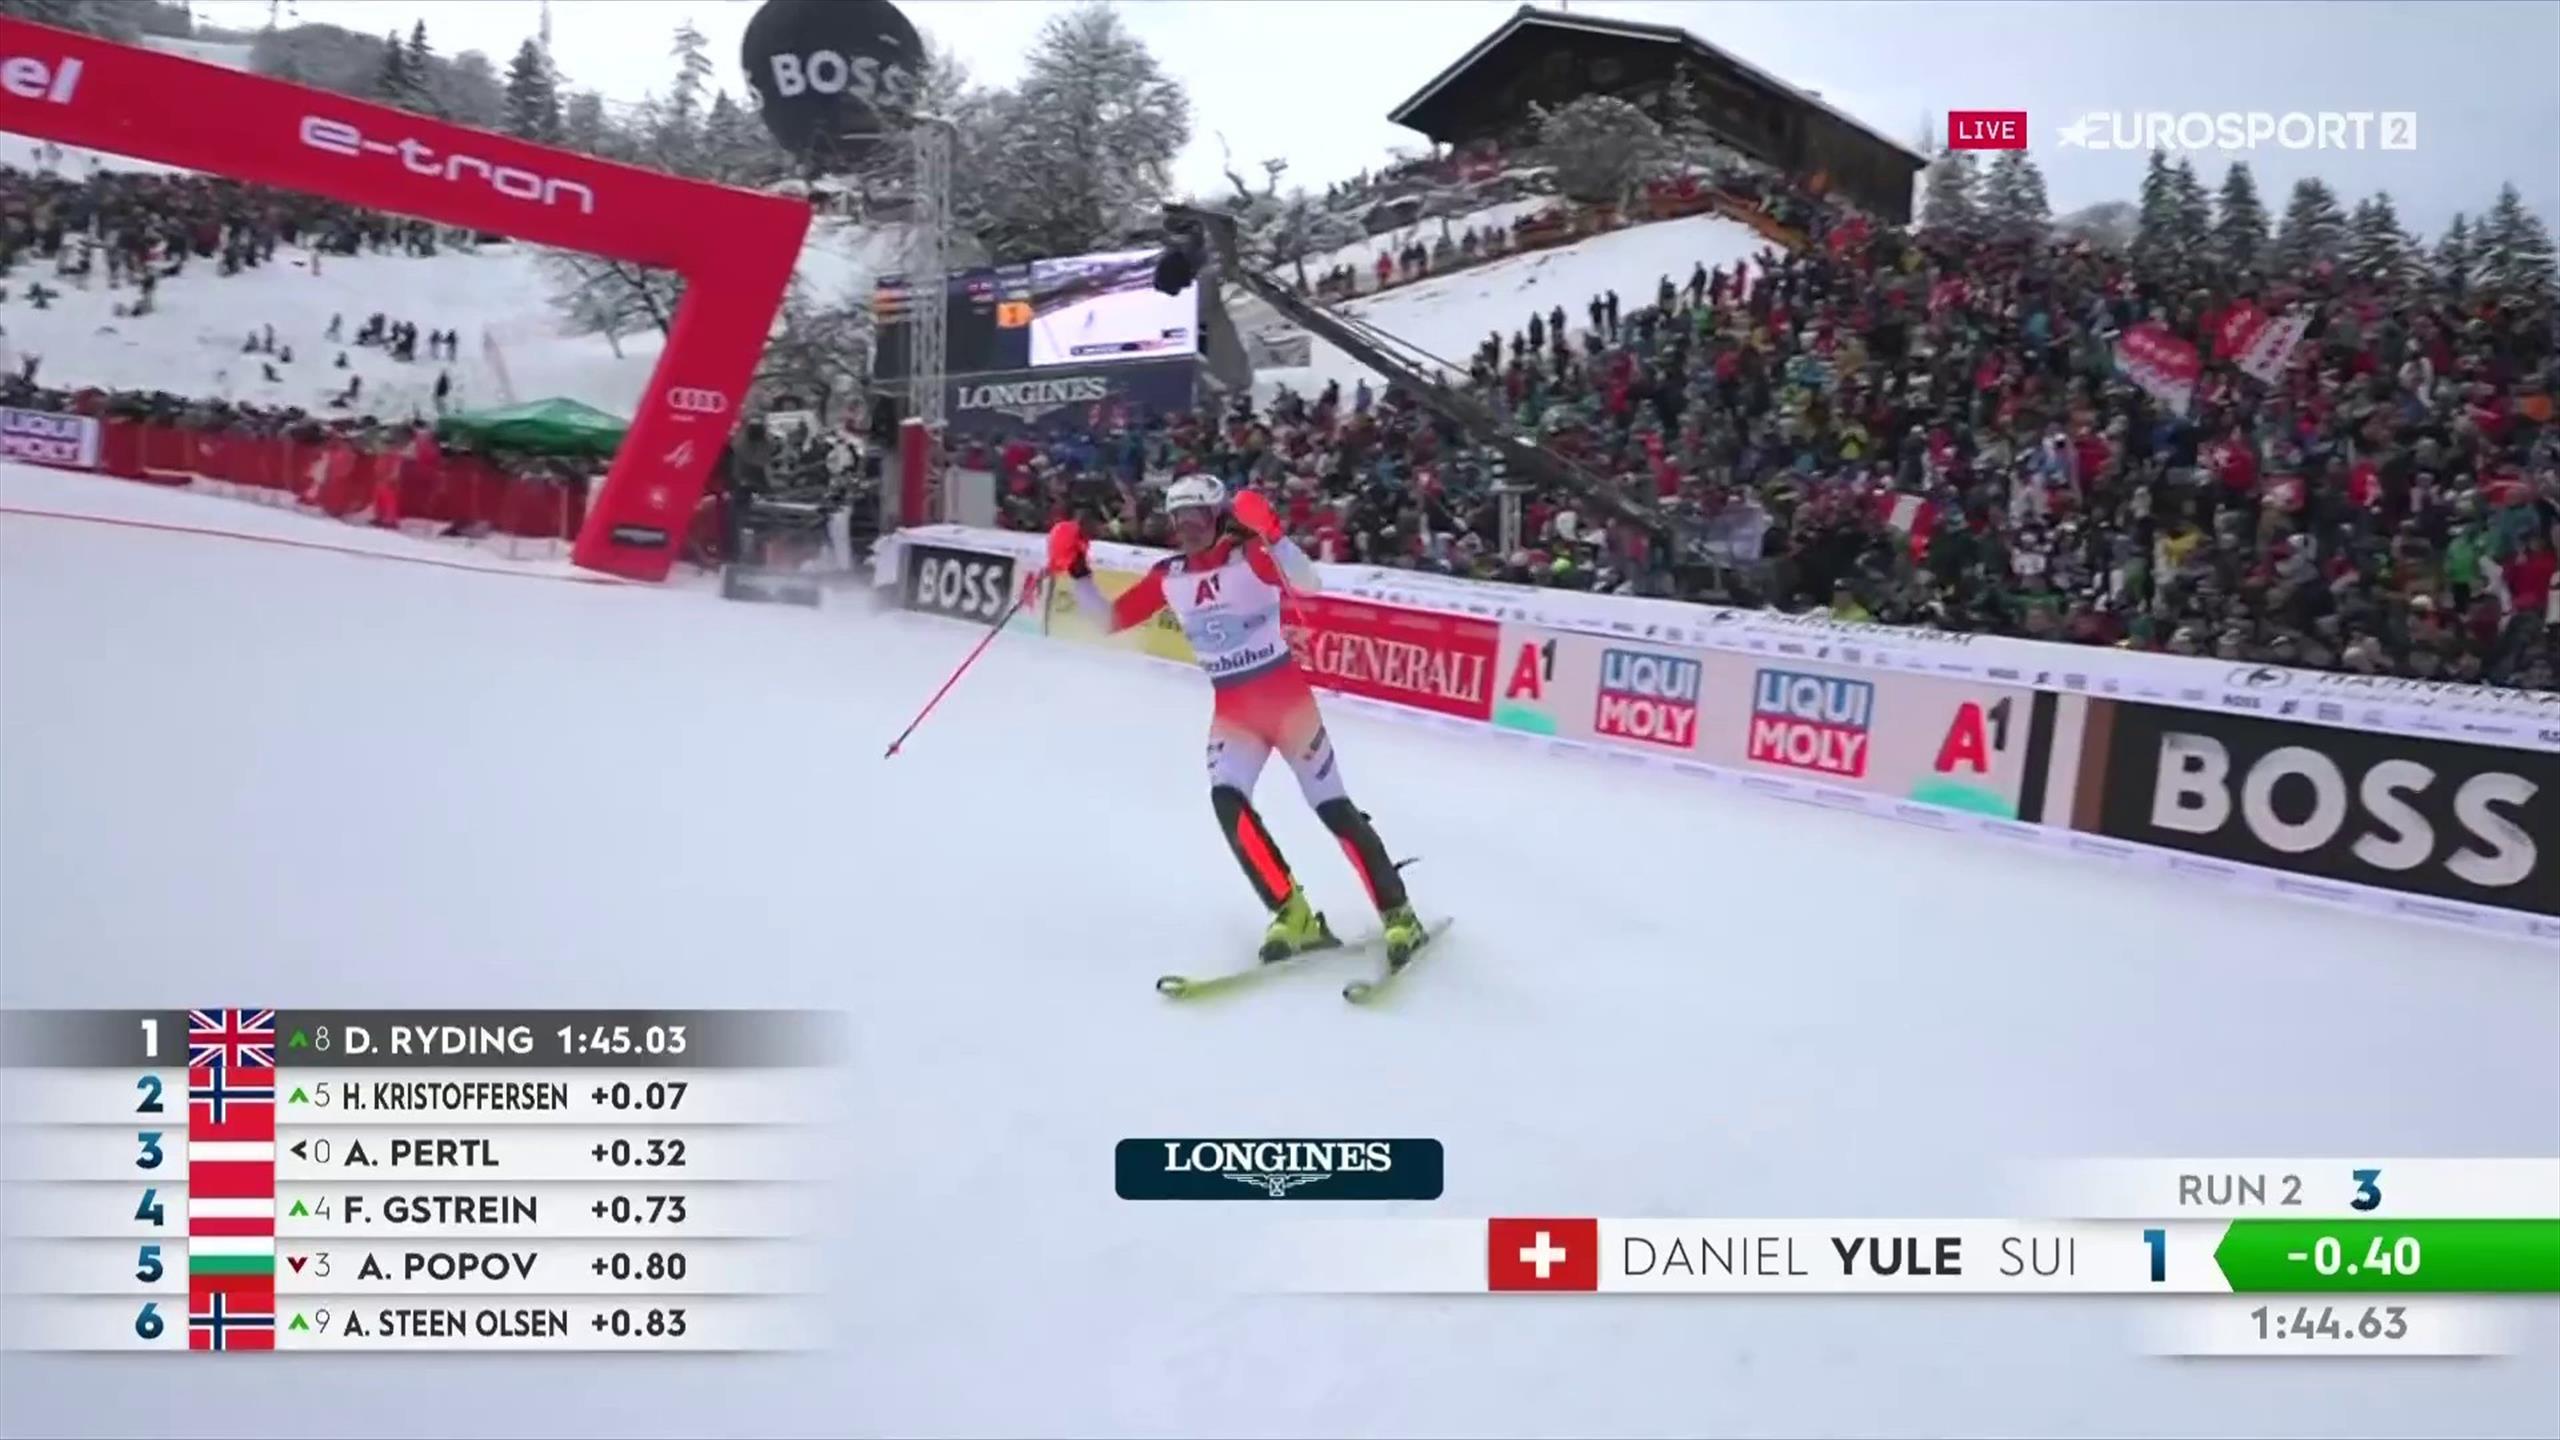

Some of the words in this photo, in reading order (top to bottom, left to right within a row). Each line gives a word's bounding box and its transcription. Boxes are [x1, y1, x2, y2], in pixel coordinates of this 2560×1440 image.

[770, 50, 914, 106] BOSS
[300, 115, 594, 213] e-tron
[957, 377, 1108, 410] LONGINES
[917, 557, 1004, 617] BOSS
[1195, 573, 1220, 606] A1
[1206, 620, 1226, 648] 5
[1315, 630, 1487, 704] GENERALI
[1506, 639, 1557, 699] A1
[1604, 651, 1697, 701] LIQUI
[1598, 696, 1695, 744] MOLY
[1756, 672, 1869, 725] LIQUI
[1752, 720, 1865, 774] MOLY
[1934, 697, 2013, 773] A1
[2150, 732, 2539, 887] BOSS
